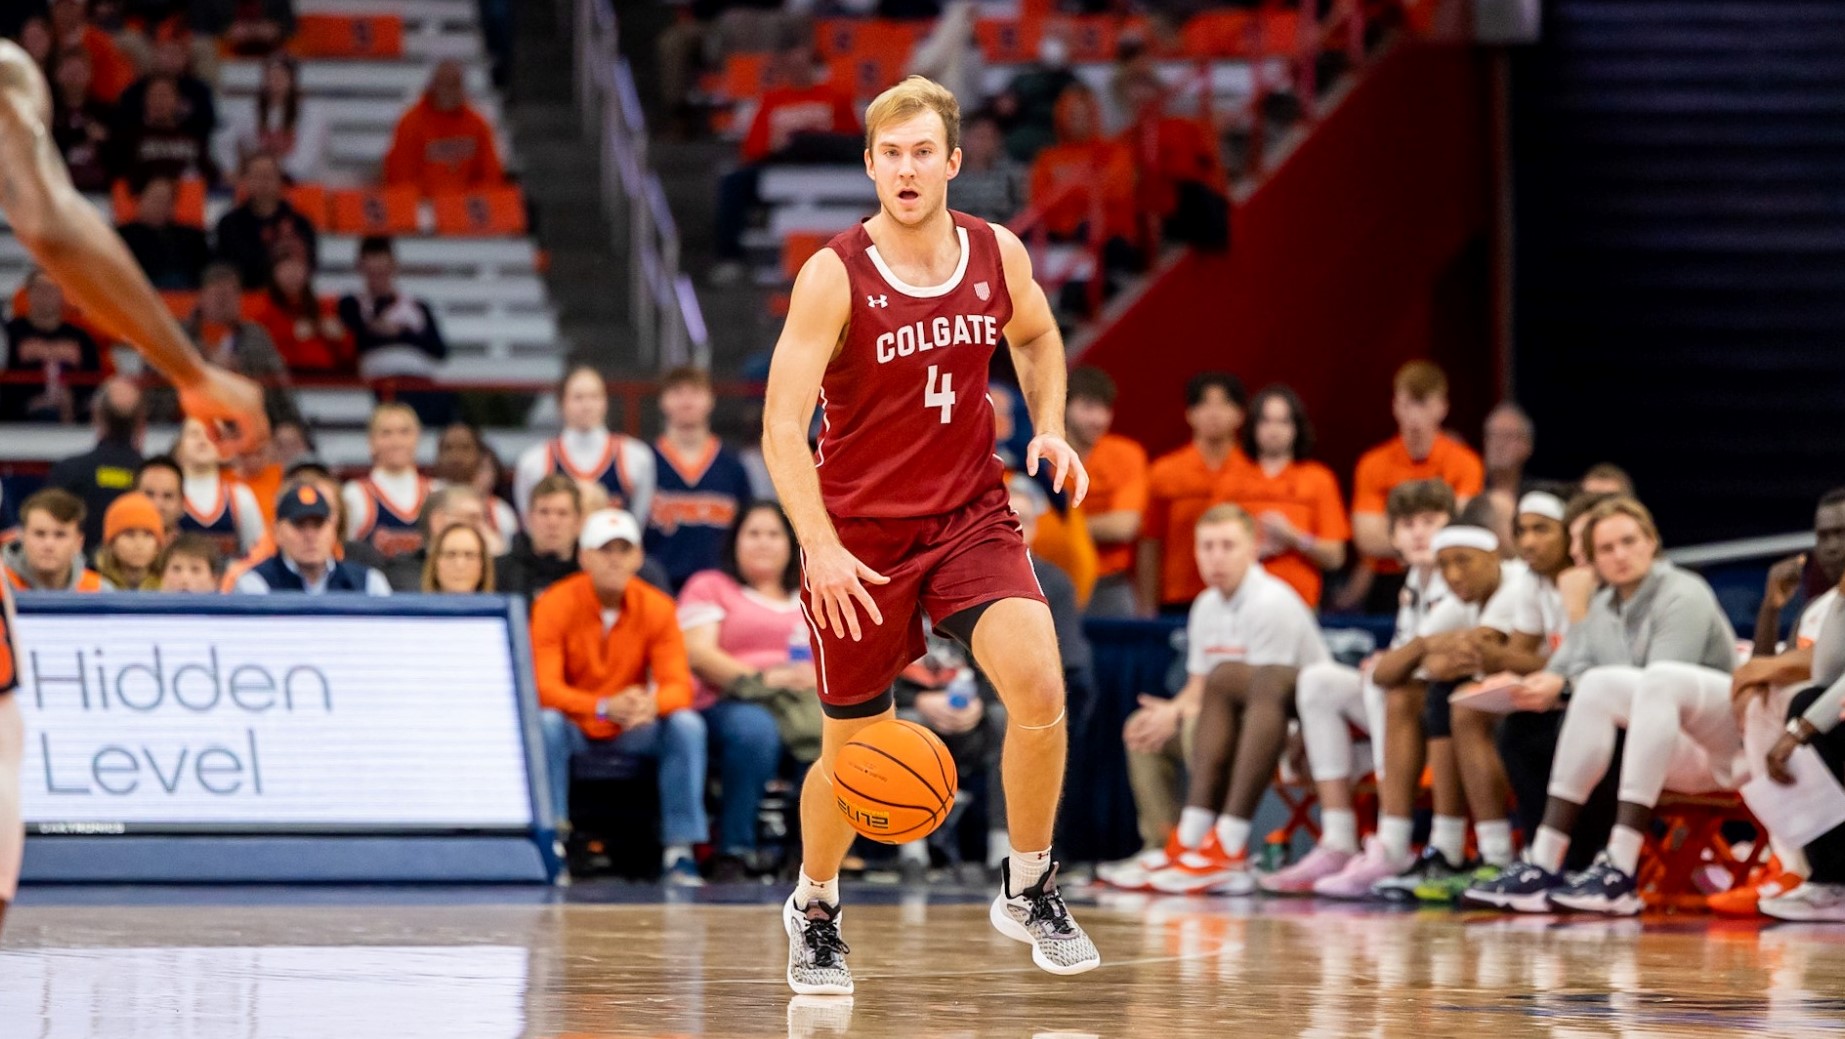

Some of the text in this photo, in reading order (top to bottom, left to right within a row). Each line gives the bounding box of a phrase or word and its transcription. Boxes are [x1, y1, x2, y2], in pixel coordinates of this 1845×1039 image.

[876, 314, 997, 364] COLGATE
[924, 365, 956, 424] 4
[30, 645, 332, 712] Hidden
[41, 727, 262, 795] Level
